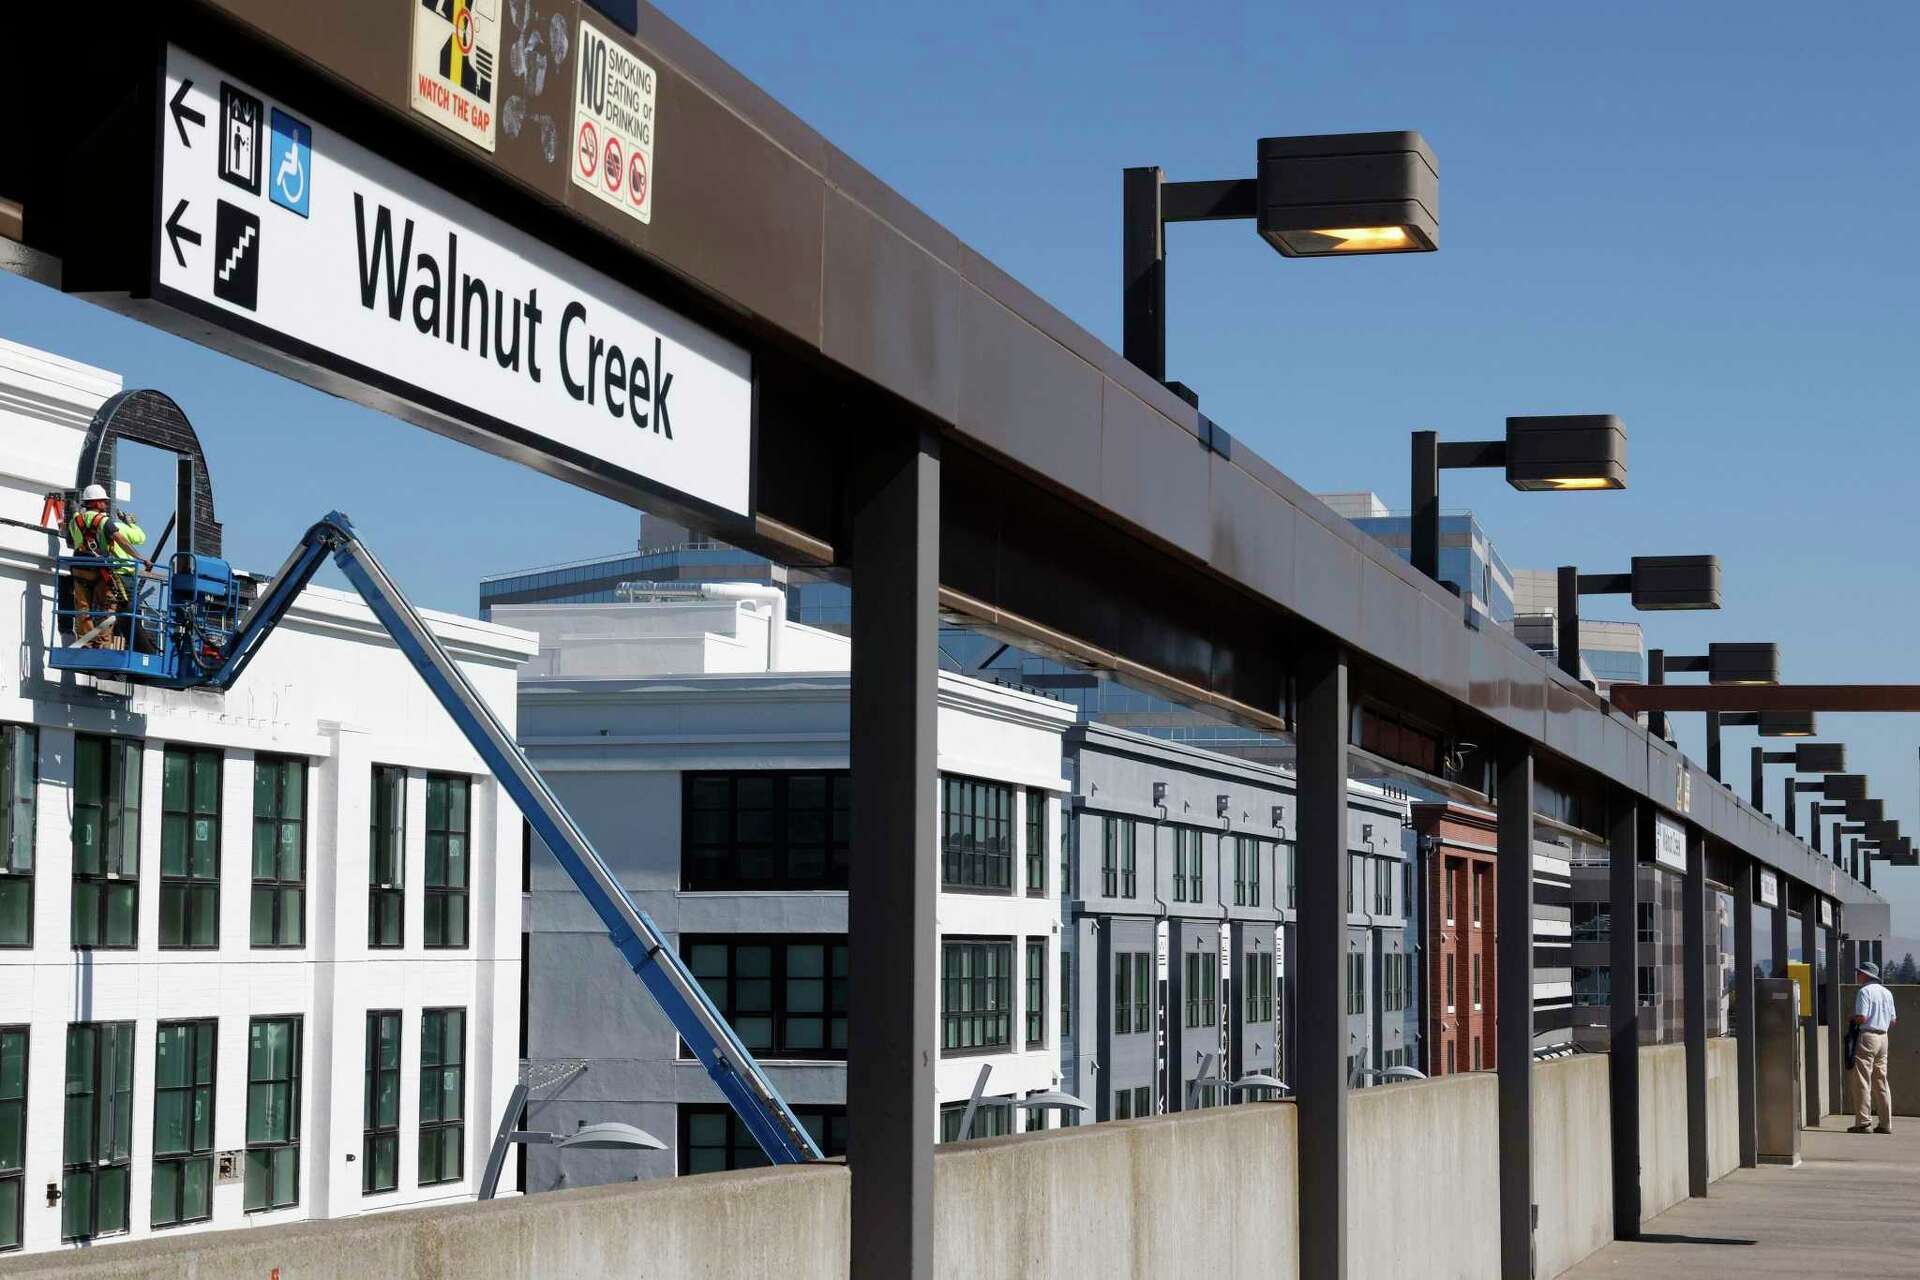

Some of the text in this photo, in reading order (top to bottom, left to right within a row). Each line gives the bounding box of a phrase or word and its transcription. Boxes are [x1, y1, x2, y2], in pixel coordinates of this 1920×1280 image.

[581, 30, 607, 116] NO
[608, 48, 652, 95] SMOKING
[418, 74, 491, 133] WATCH THE GAP
[605, 102, 650, 145] DRINKING
[607, 75, 653, 122] EATING or
[353, 192, 674, 440] Walnut Creek
